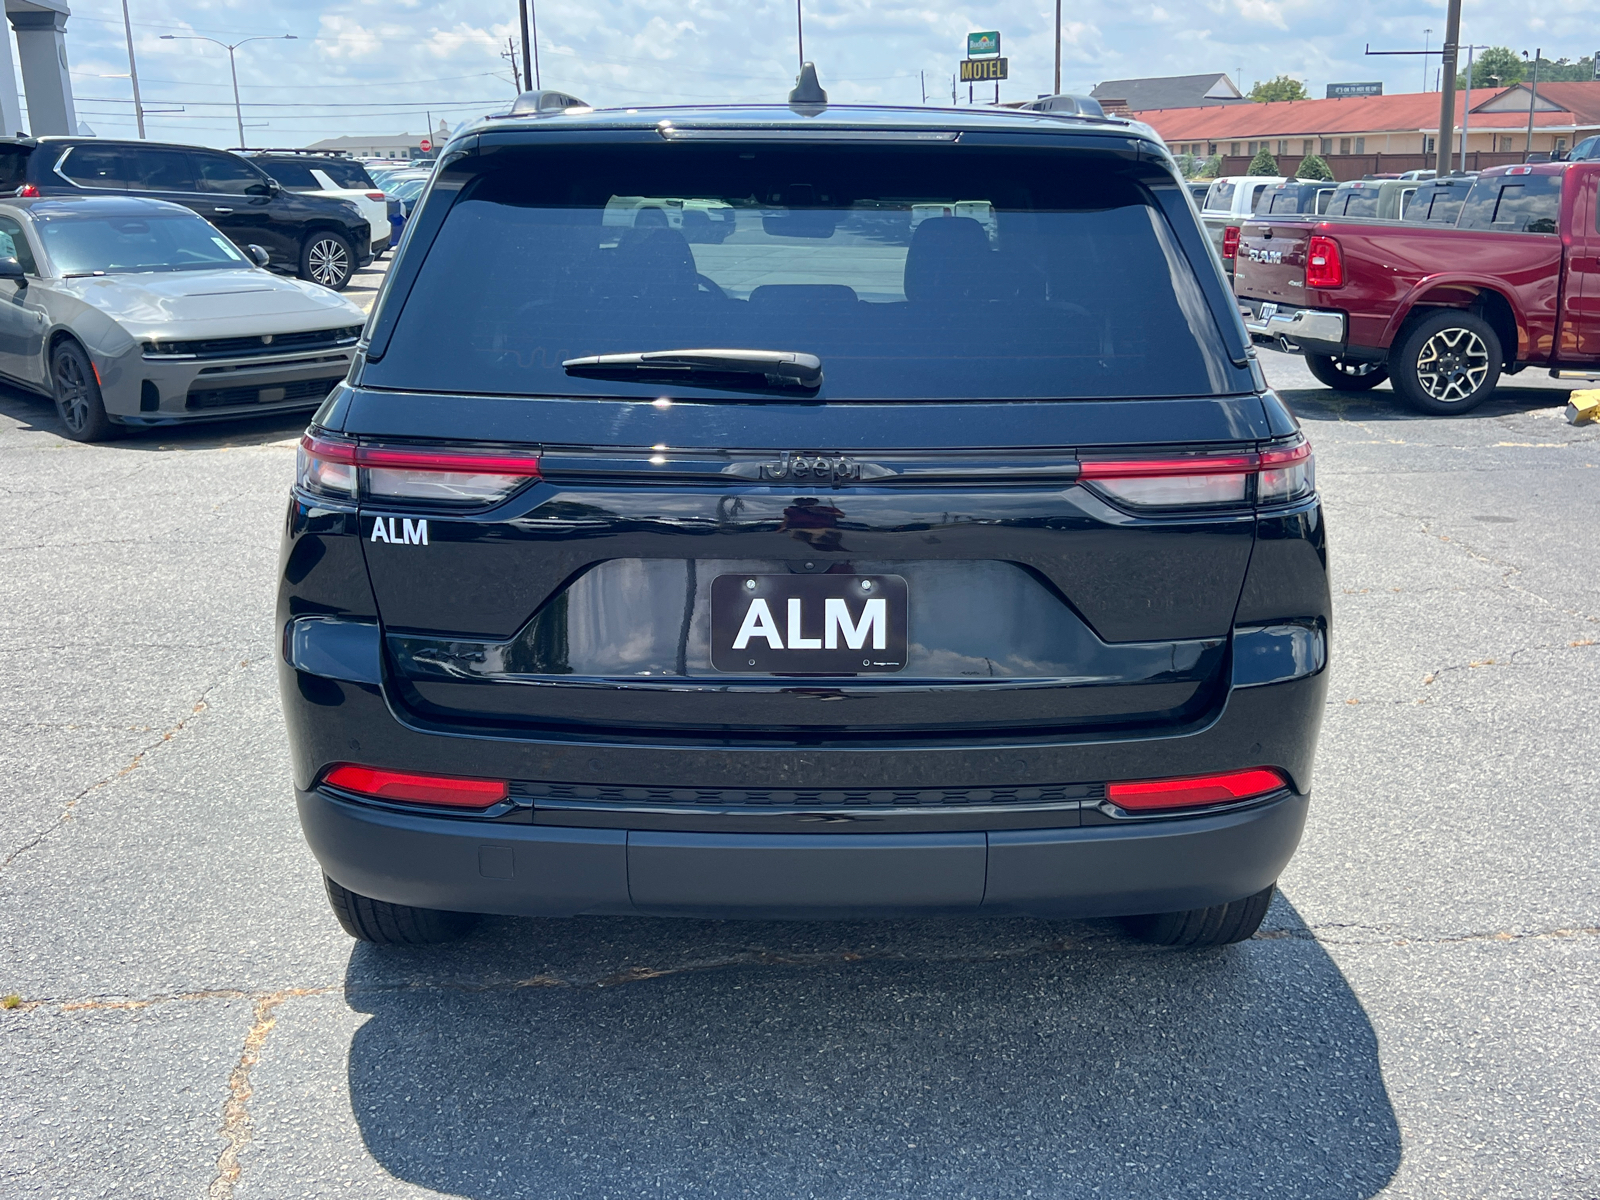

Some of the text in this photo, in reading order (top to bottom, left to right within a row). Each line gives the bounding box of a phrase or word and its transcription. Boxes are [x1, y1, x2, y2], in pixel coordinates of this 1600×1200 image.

[961, 61, 1003, 79] MOTEL
[1248, 249, 1282, 264] RAM
[767, 451, 854, 490] Jeep
[370, 516, 429, 546] ALM
[732, 598, 887, 650] ALM
